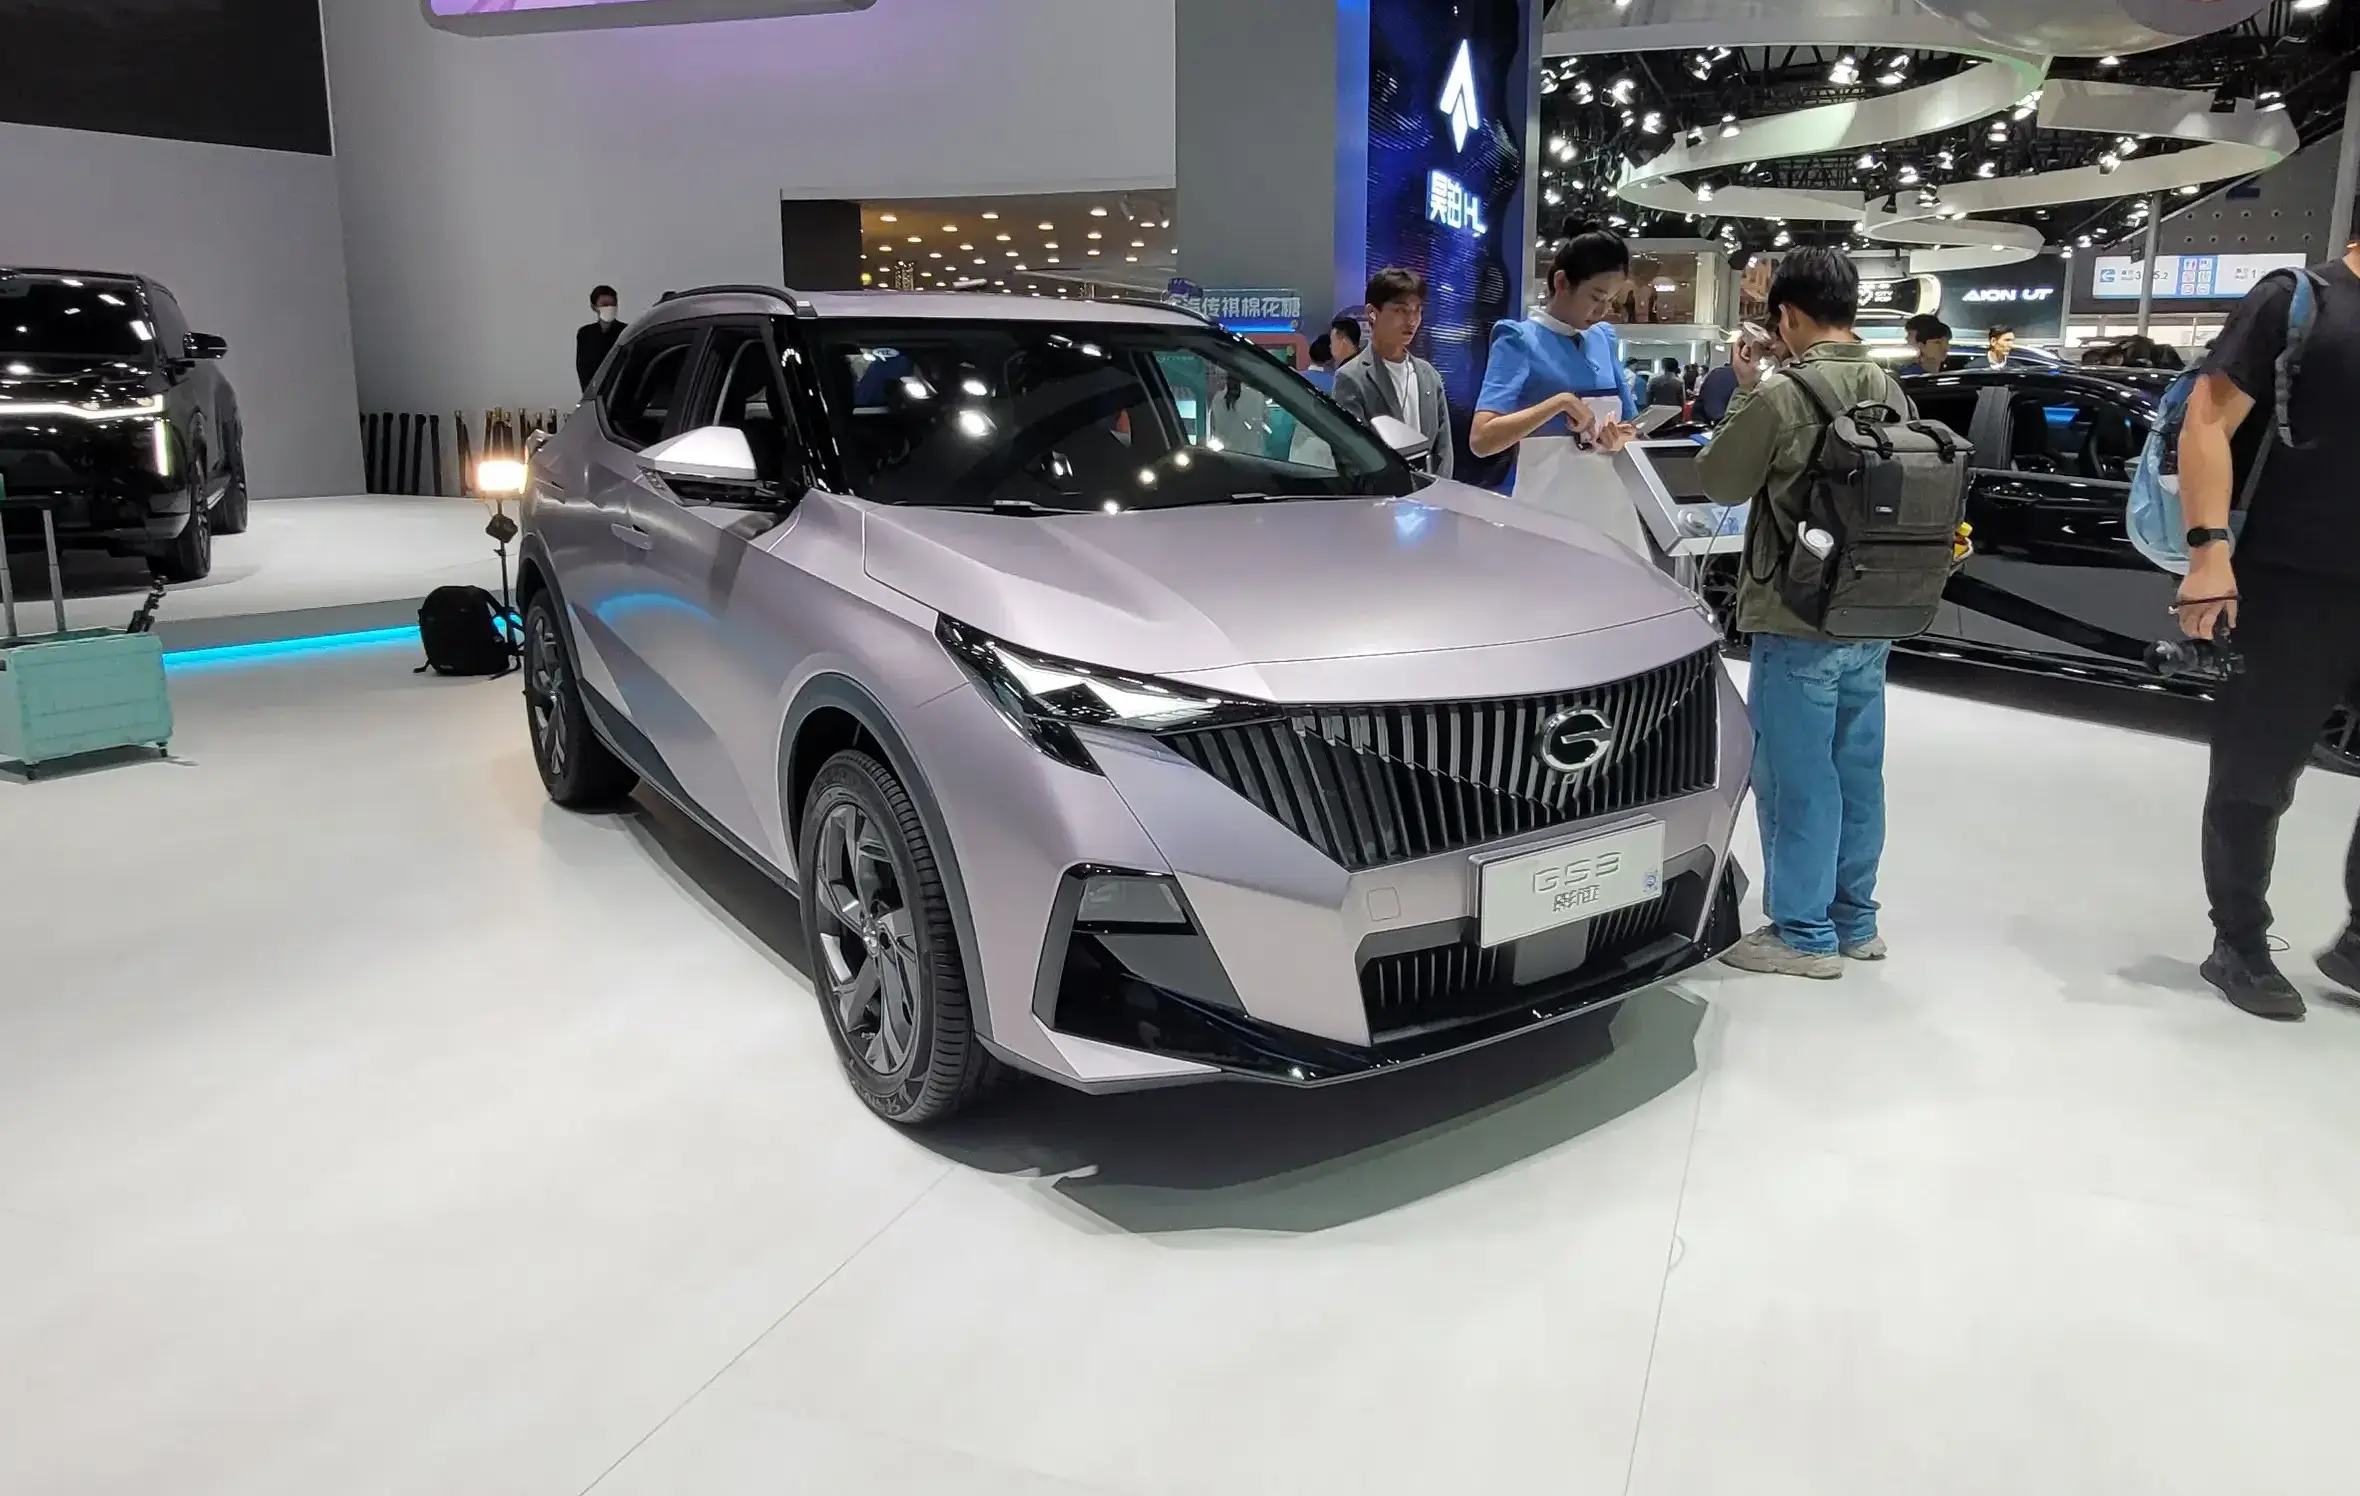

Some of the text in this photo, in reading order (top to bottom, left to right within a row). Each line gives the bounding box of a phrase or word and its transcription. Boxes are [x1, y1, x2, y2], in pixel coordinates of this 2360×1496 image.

[1174, 295, 1301, 319] 汽传祺棉花糖
[1961, 288, 2054, 302] AION UT
[1532, 851, 1622, 893] GS3
